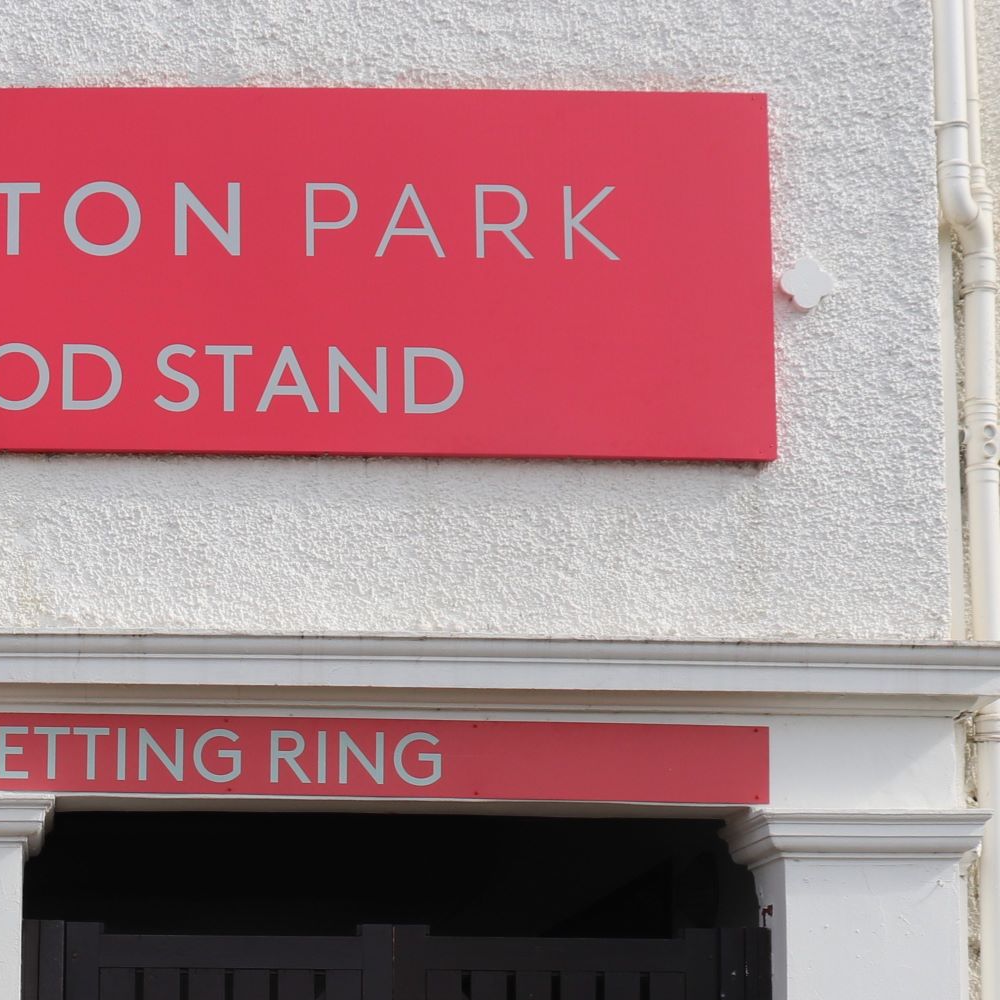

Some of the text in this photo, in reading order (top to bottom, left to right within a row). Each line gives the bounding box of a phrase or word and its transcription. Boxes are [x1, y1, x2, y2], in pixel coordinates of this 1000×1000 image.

[307, 184, 619, 262] PARK
[156, 345, 466, 415] STAND
[269, 729, 443, 786] RING
